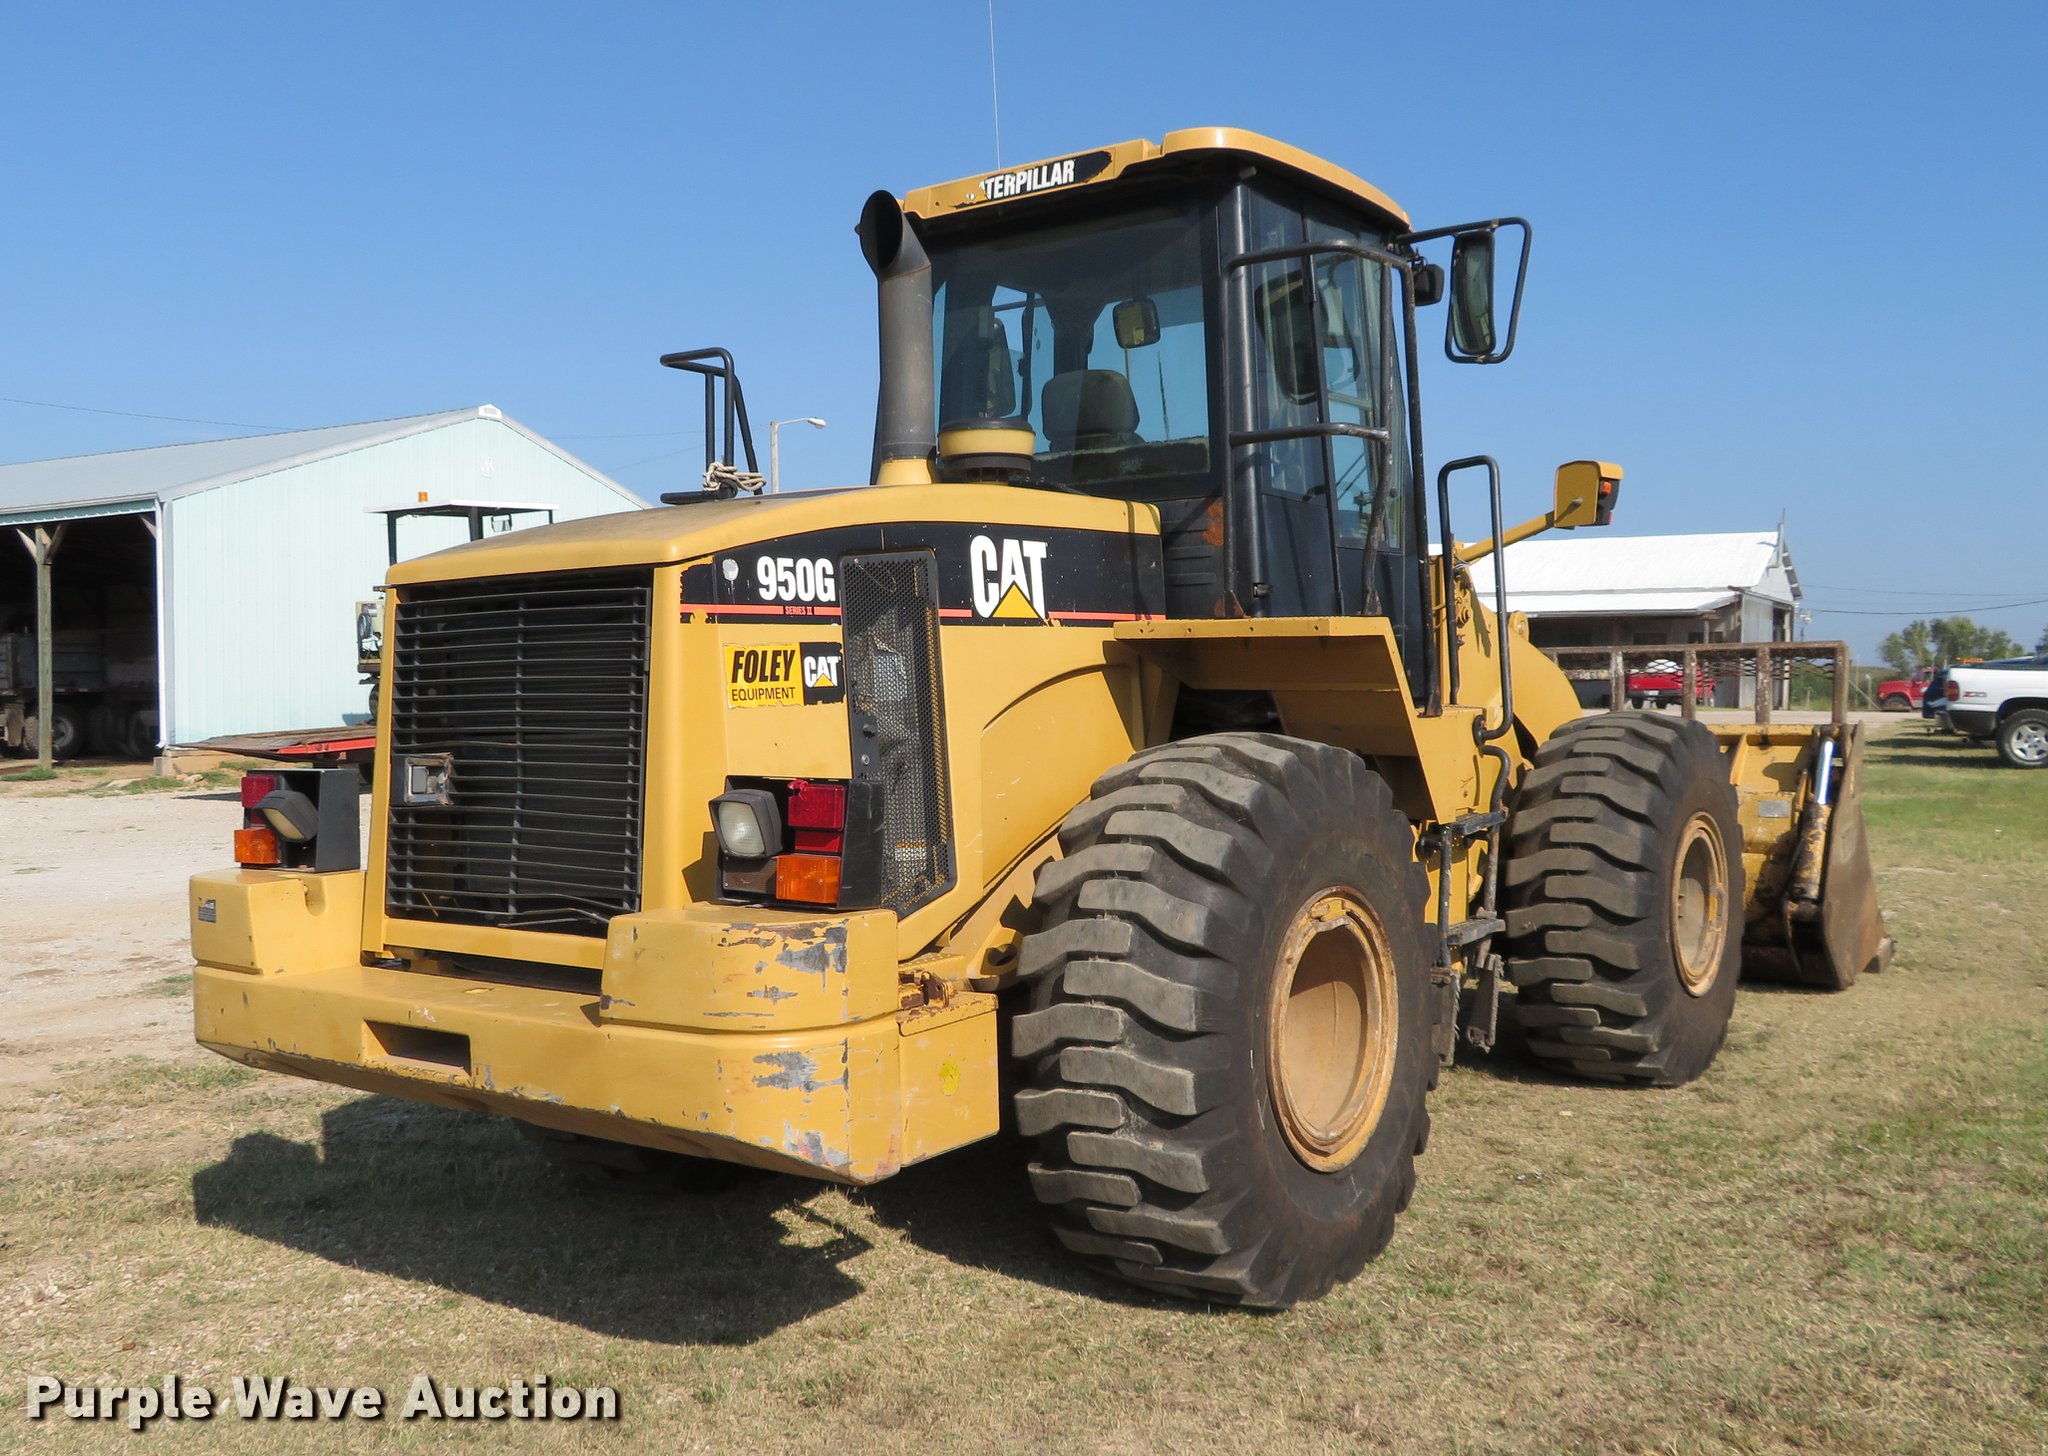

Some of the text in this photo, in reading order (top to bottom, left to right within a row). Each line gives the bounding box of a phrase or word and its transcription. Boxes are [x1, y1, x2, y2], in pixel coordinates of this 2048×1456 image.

[977, 159, 1076, 200] TERPILLAR
[757, 556, 836, 601] 950G
[970, 535, 1048, 620] CAT
[785, 605, 806, 615] SERIES
[731, 650, 796, 683] FOLEY
[803, 656, 840, 688] CAT
[731, 687, 796, 701] EQUIPMENT
